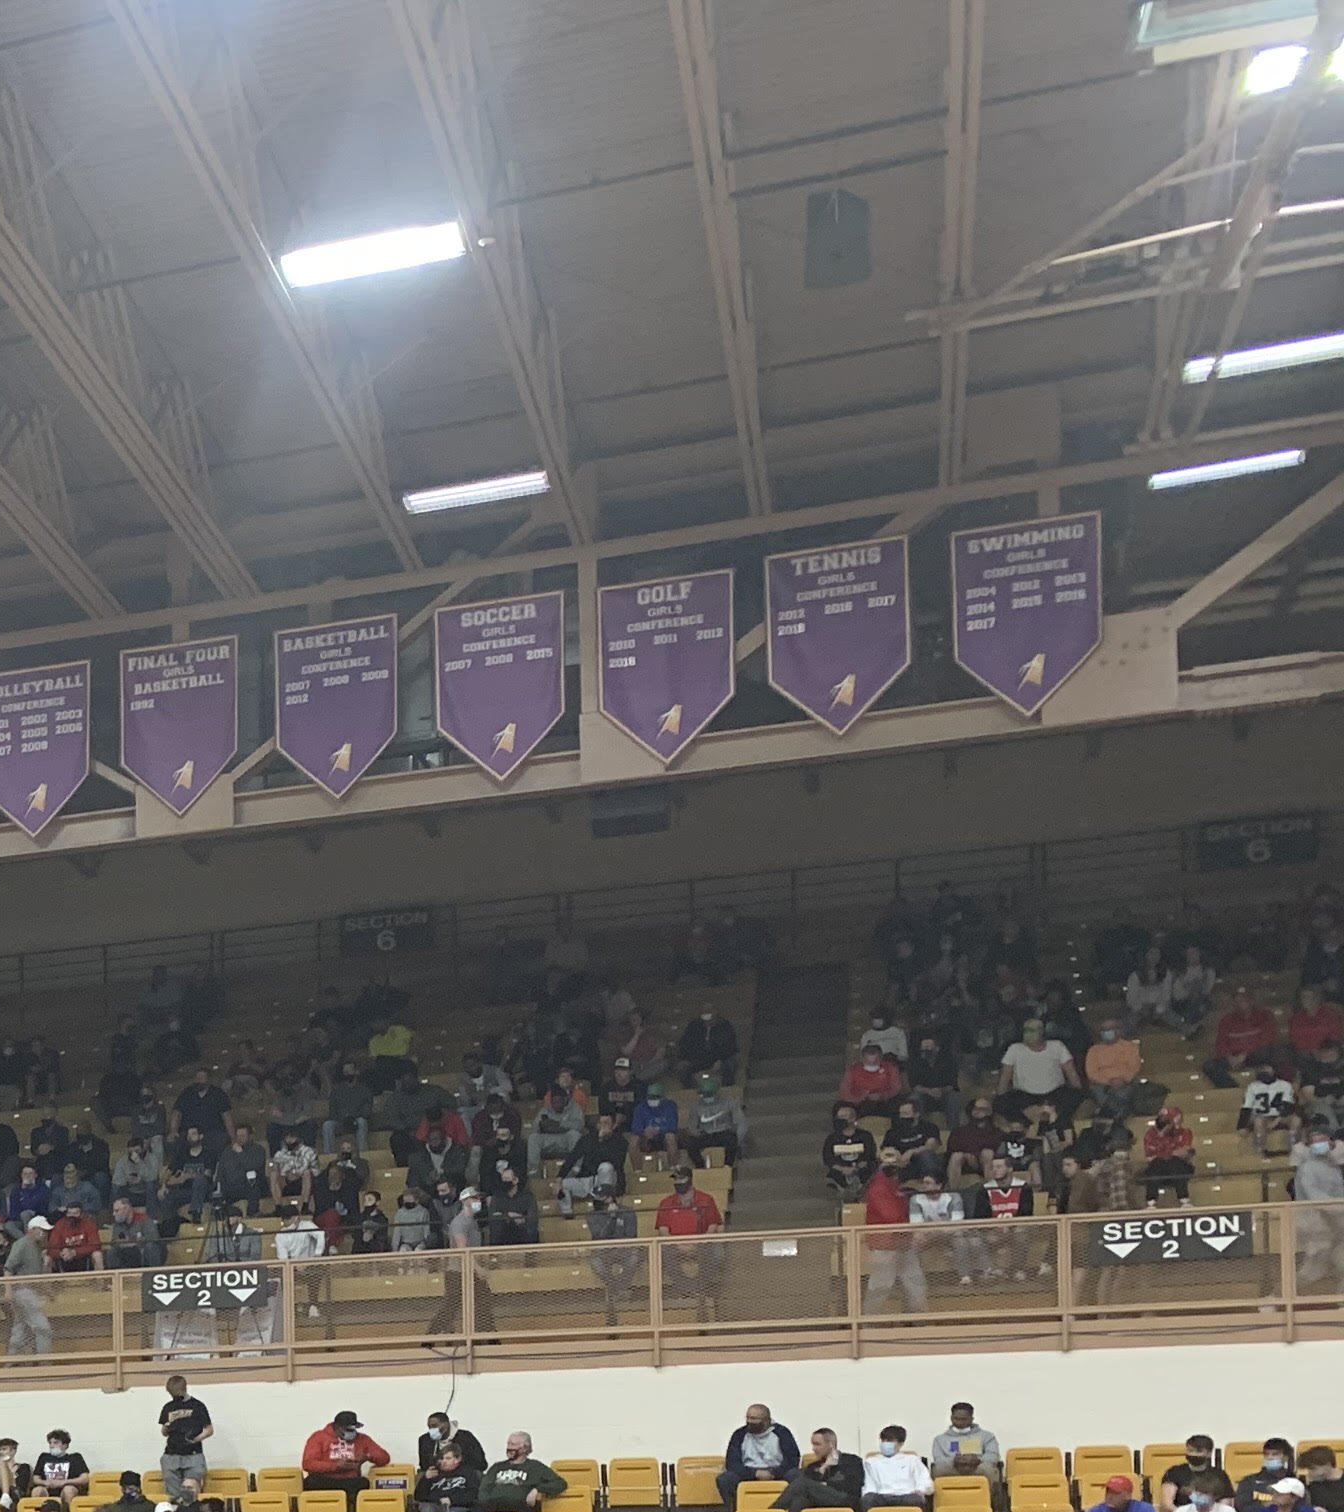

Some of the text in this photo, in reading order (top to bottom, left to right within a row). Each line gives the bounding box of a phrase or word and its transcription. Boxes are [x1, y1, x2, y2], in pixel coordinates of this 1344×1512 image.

[967, 524, 1085, 555] SWIMMING
[791, 546, 882, 576] TENNIS
[982, 558, 1069, 580] CONFERENCE
[817, 571, 856, 586] GIRLS
[636, 581, 693, 606] GOLF
[796, 580, 878, 603] CONFERENCE
[460, 603, 537, 628] SOCCER
[647, 604, 683, 617] GIRLS
[481, 624, 516, 638] GIRLS
[626, 613, 705, 633] CONFERENCE
[282, 624, 389, 652] BASKETBALL
[462, 634, 537, 653] CONFERENCE
[127, 645, 231, 672] FINAL FOUR
[319, 647, 352, 660] GIRLS
[163, 664, 196, 678] GIRLS
[301, 656, 371, 675] CONFERENCE
[133, 673, 225, 696] BASKETBALL
[0, 696, 66, 714] CONFERENCE
[1102, 1215, 1240, 1242] SECTION
[1162, 1240, 1181, 1258] 2
[152, 1269, 258, 1291] SECTION
[197, 1290, 212, 1306] 2
